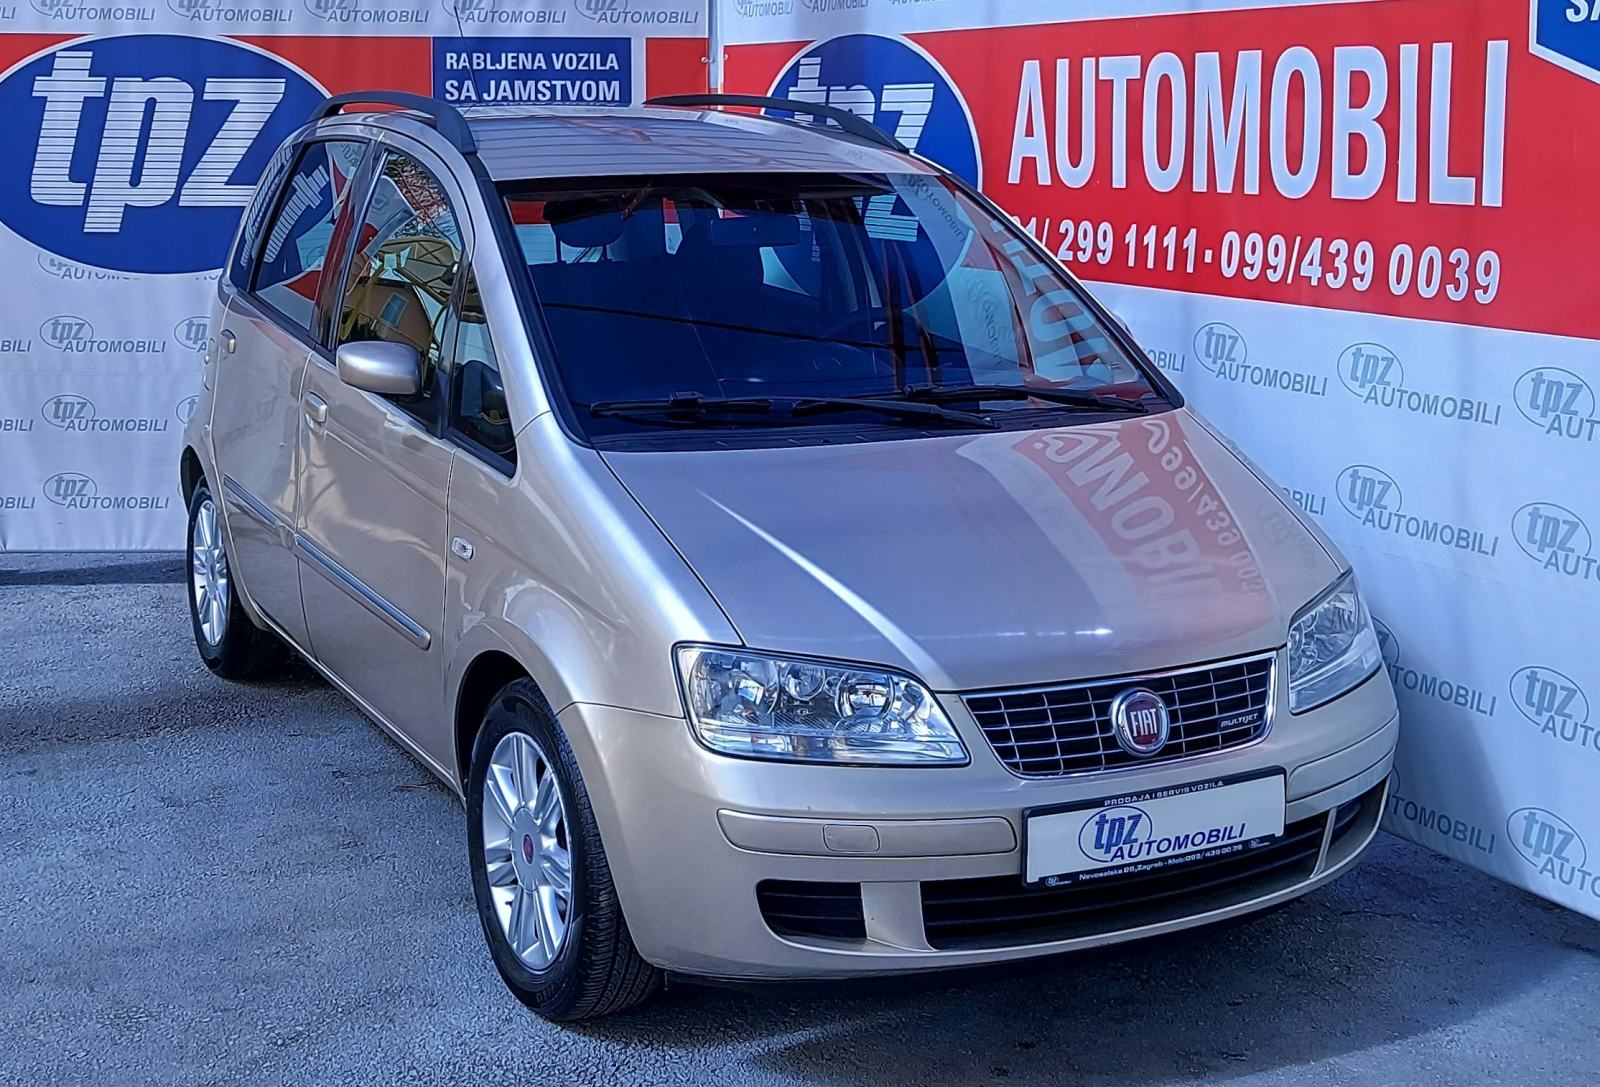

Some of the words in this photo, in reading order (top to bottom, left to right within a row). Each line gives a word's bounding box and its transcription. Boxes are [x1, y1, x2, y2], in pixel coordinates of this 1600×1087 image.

[52, 8, 156, 21] AUTOMOBILI
[191, 9, 292, 22] AUTOMOBILI
[327, 10, 429, 23] AUTOMOBILI
[464, 10, 566, 23] AUTOMOBILI
[597, 11, 699, 24] AUTOMOBILI
[445, 53, 547, 70] RABLJENA
[551, 53, 620, 70] VOZILA
[445, 80, 477, 101] SA
[483, 80, 620, 101] JAMSTVOM
[1007, 39, 1509, 207] AUTOMOBILI
[30, 51, 286, 233] tpz
[1057, 219, 1114, 264] 299
[1388, 243, 1502, 304] 0039
[51, 319, 86, 344] tpz
[63, 340, 166, 353] AUTOMOBILI
[185, 320, 208, 345] tp
[1203, 326, 1242, 364] tpz
[1215, 361, 1328, 397] AUTOMOBILI
[1350, 346, 1394, 388] tpz
[1363, 385, 1502, 426] AUTOMOBILI
[1529, 371, 1584, 418] tpz
[0, 419, 33, 432] BILI
[53, 398, 88, 423] tpz
[64, 419, 168, 432] AUTOMOBILI
[54, 475, 90, 500] tpz
[1348, 469, 1392, 511] tpz
[66, 497, 169, 510] AUTOMOBILI
[1362, 507, 1498, 557] AUTOMOBILI
[1526, 506, 1580, 553] tpz
[1543, 550, 1600, 581] AUT
[1388, 663, 1497, 717] TOMOBILI
[1524, 669, 1579, 720] tpz
[1130, 708, 1158, 737] FIAT
[1104, 793, 1150, 807] PRODAJA
[1156, 787, 1190, 799] SERVIS
[1191, 780, 1224, 792] VOZILA
[1094, 812, 1142, 855] tpz
[1387, 793, 1495, 854] TOMOBILI
[1522, 810, 1576, 864] tpz
[1109, 823, 1246, 863] AUTOMOBILI
